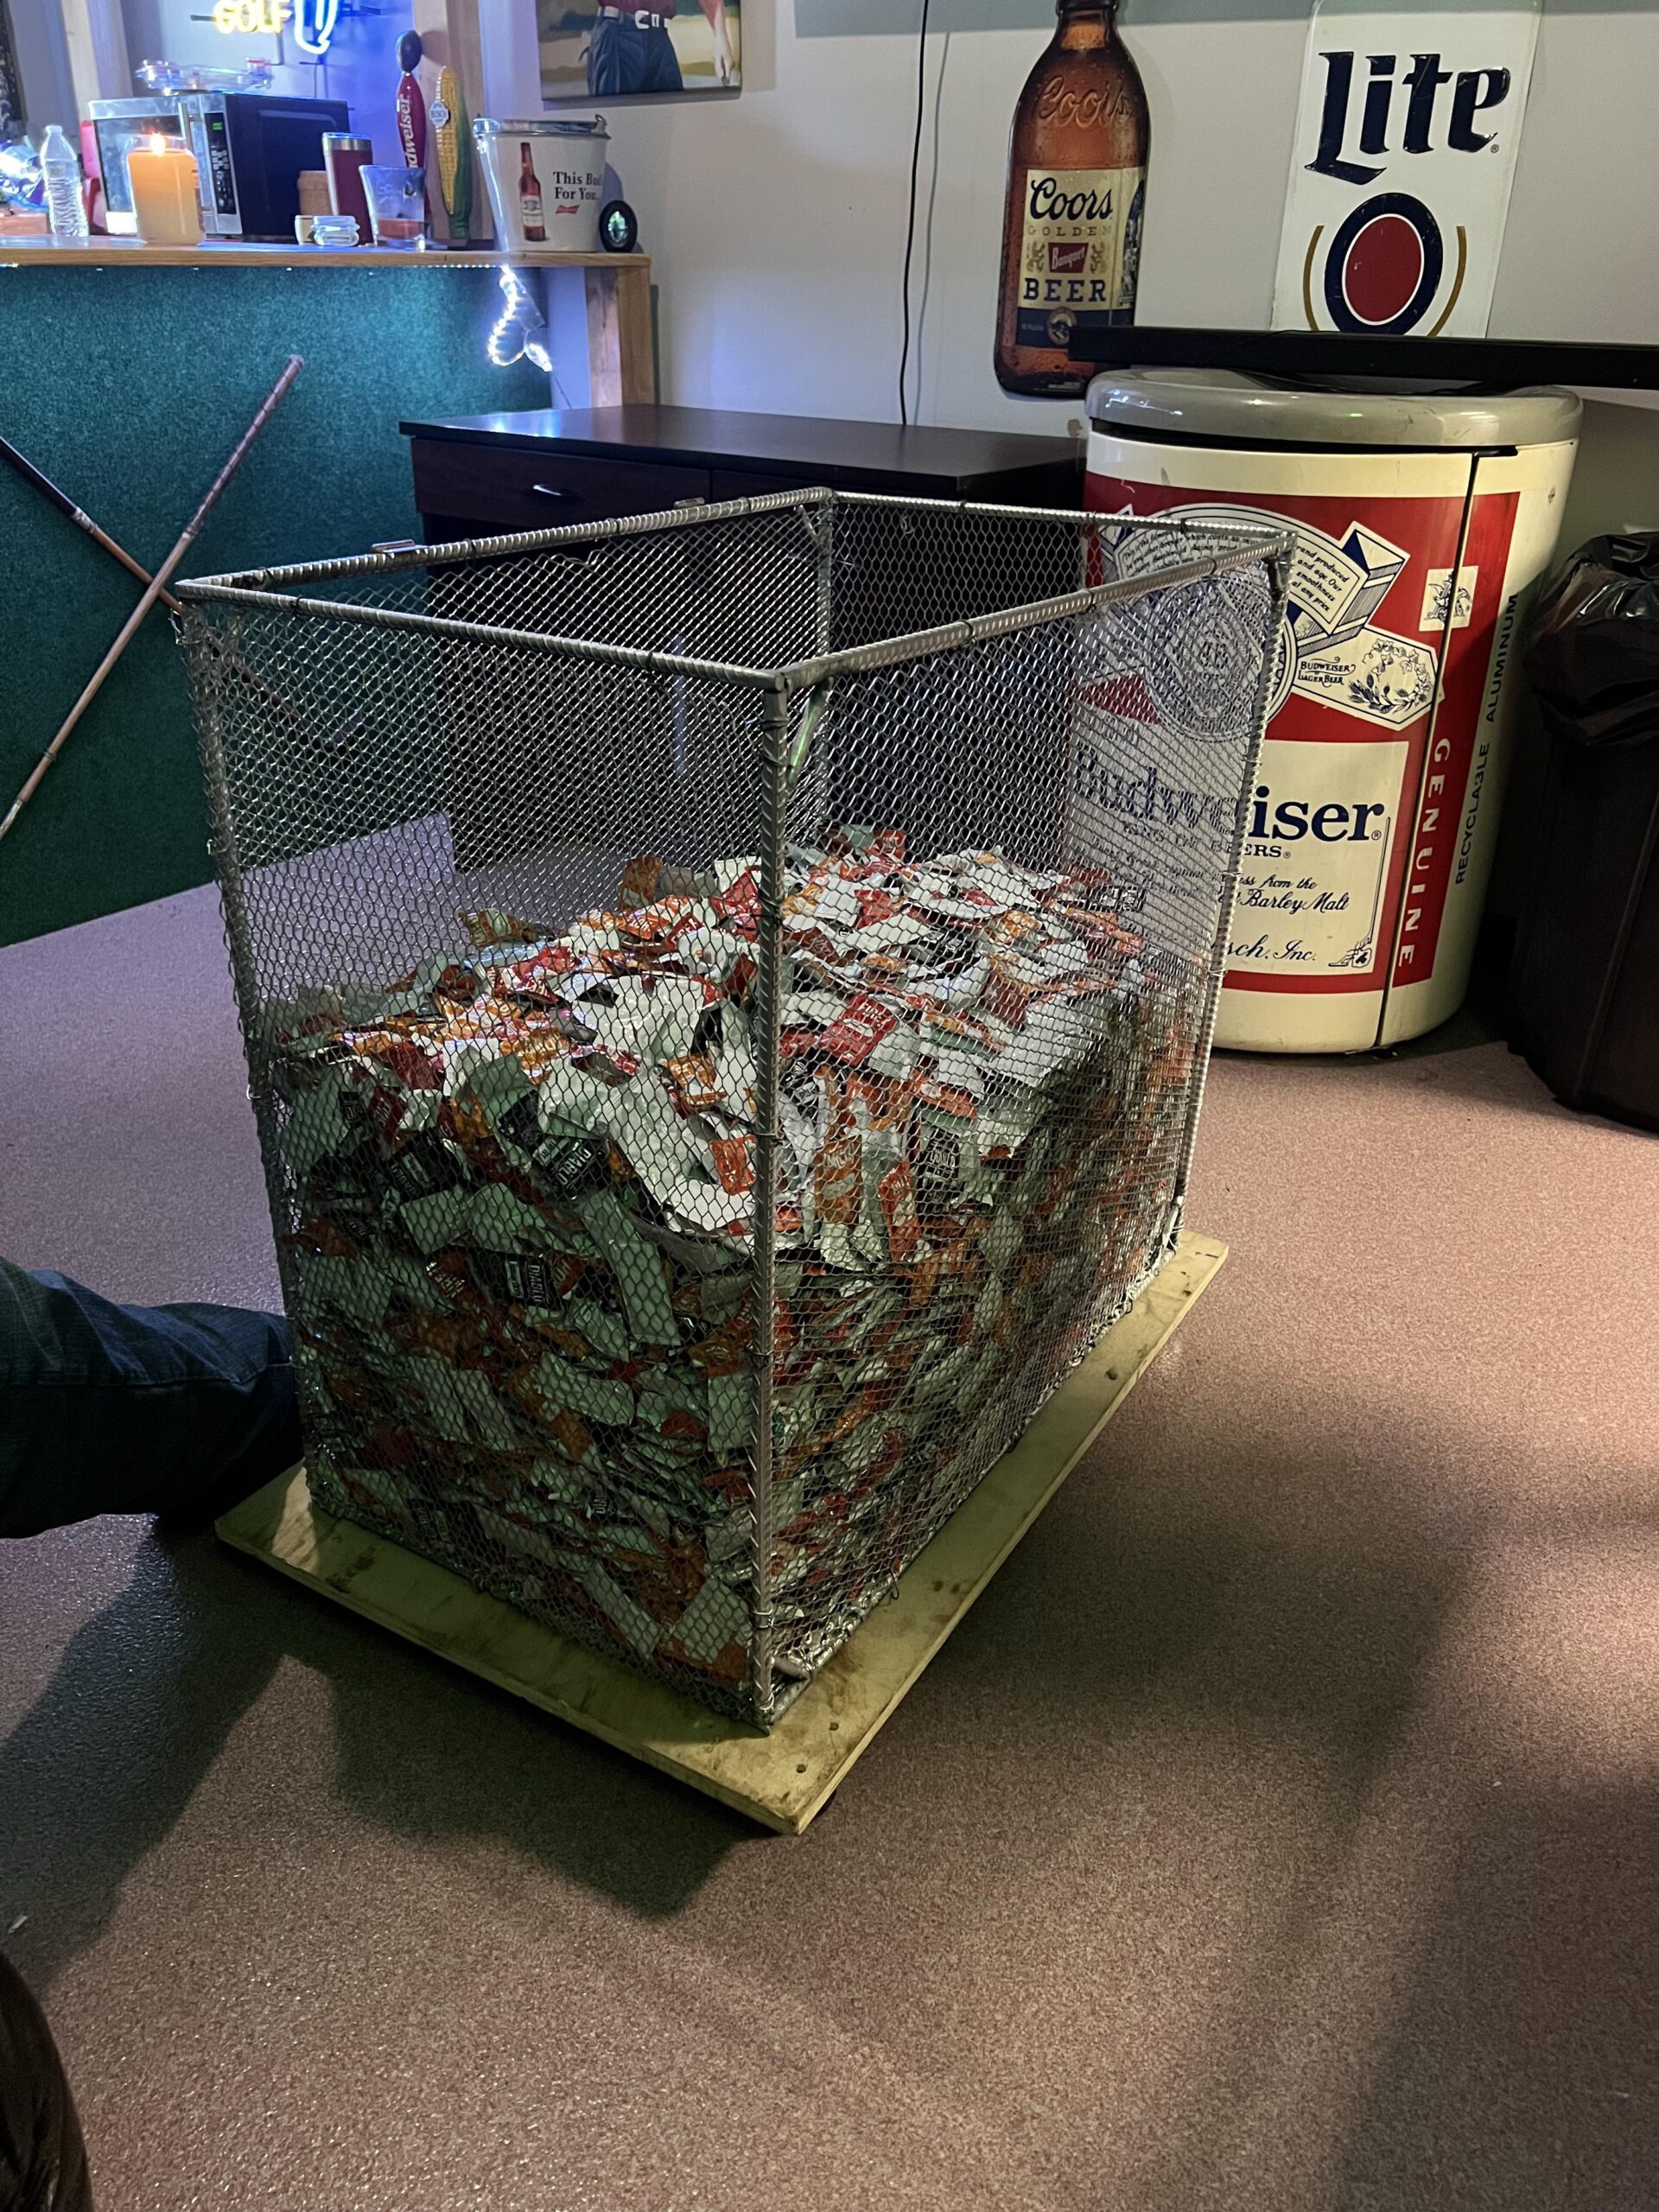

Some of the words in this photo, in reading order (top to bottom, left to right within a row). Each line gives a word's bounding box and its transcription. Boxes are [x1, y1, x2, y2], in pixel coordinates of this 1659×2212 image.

[213, 0, 292, 35] GOLF
[1037, 75, 1132, 128] Coors
[399, 93, 419, 168] dweiser
[1304, 51, 1511, 186] Lite
[553, 171, 582, 185] This
[555, 187, 576, 200] For
[1029, 176, 1114, 221] Coors
[1027, 226, 1112, 237] GOLDEN
[1023, 277, 1107, 302] BEER
[1297, 559, 1314, 571] and
[1328, 576, 1342, 592] Our
[1316, 556, 1351, 583] produced
[1296, 571, 1336, 602] smoothness
[1300, 587, 1314, 600] any
[1313, 597, 1331, 613] price
[1300, 661, 1351, 672] BUDWEISER
[1455, 742, 1491, 886] RECYCLABLE
[1485, 593, 1519, 724] ALUMINUM
[1398, 738, 1452, 968] GENUINE
[1260, 874, 1293, 889] from
[1296, 876, 1318, 890] the
[1241, 888, 1305, 914] Barley
[1303, 892, 1351, 914] Malt
[1272, 939, 1317, 961] Inc.
